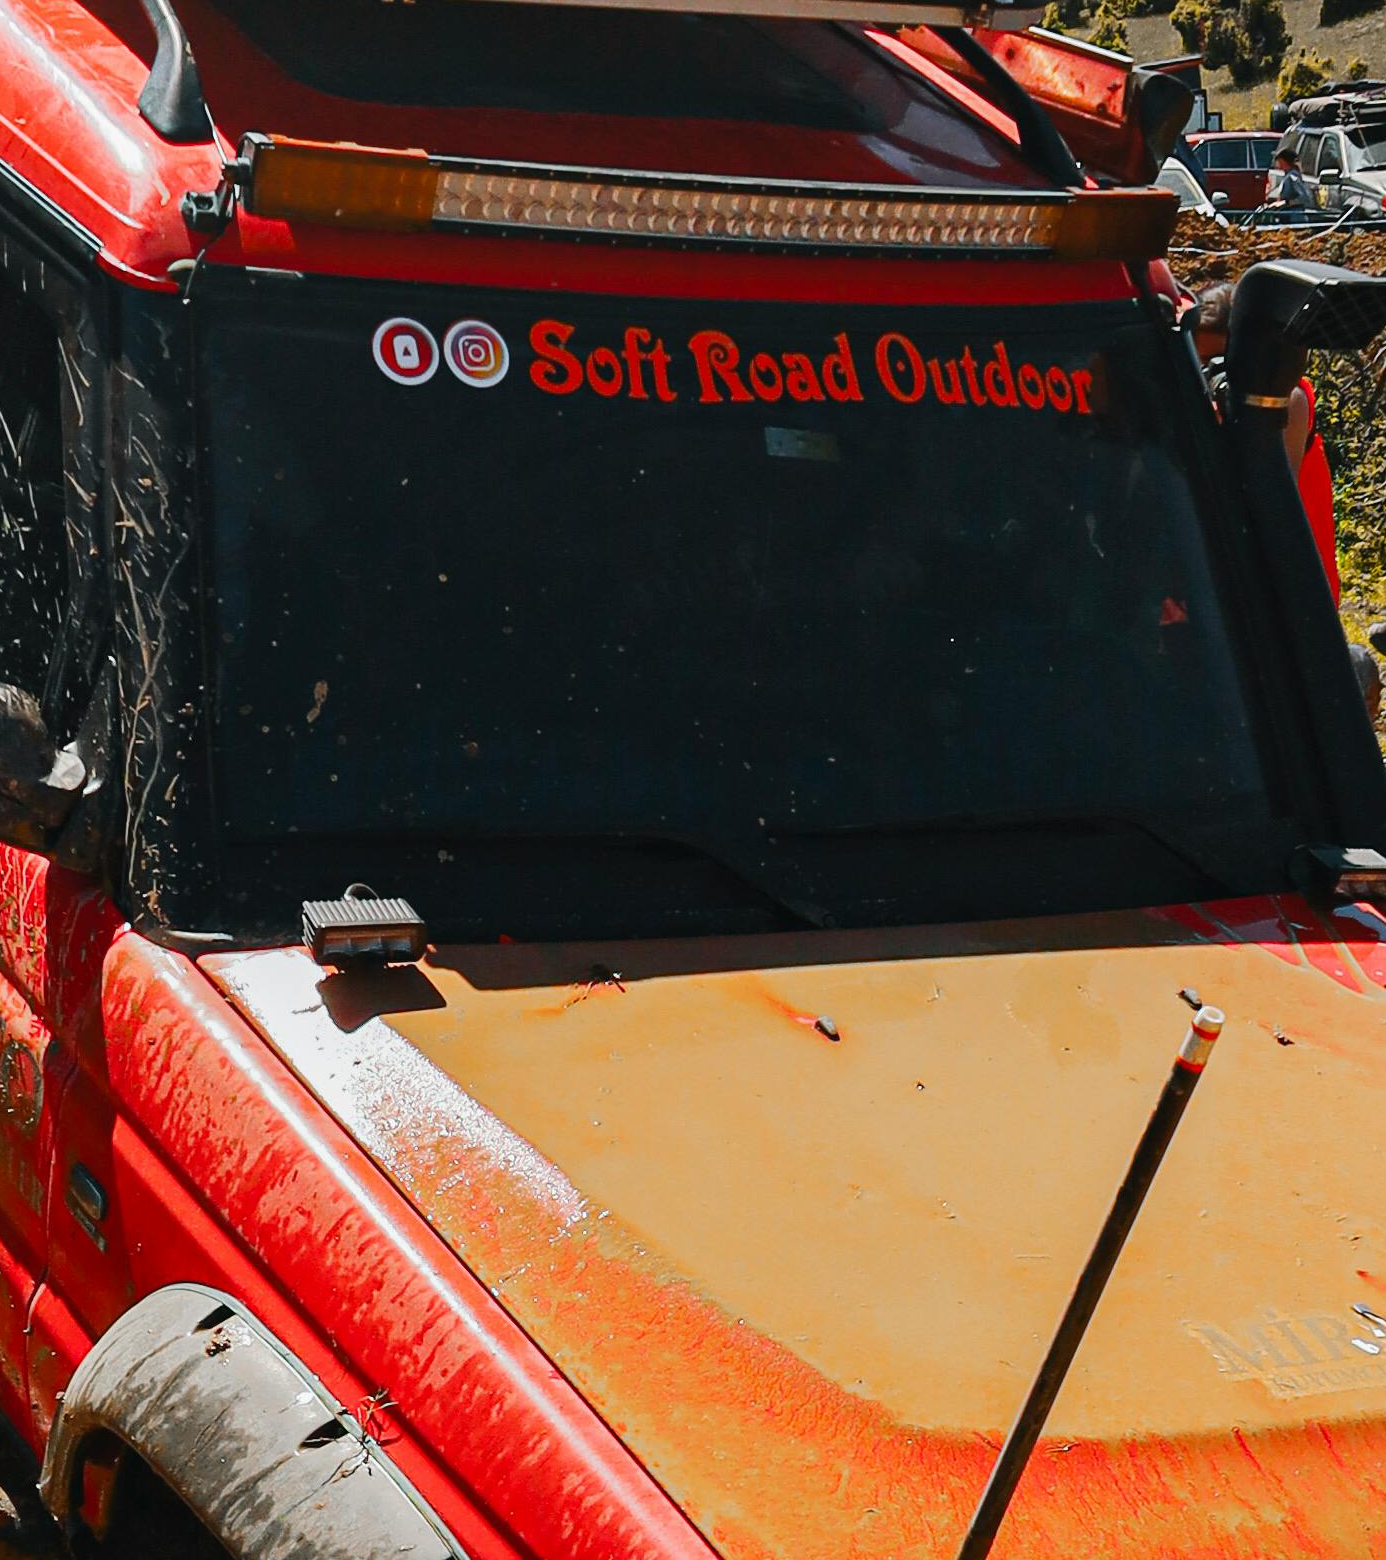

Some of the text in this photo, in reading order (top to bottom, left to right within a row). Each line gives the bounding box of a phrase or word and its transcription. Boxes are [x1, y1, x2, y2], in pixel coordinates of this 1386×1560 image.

[528, 318, 1093, 416] Soft Road Outdoor
